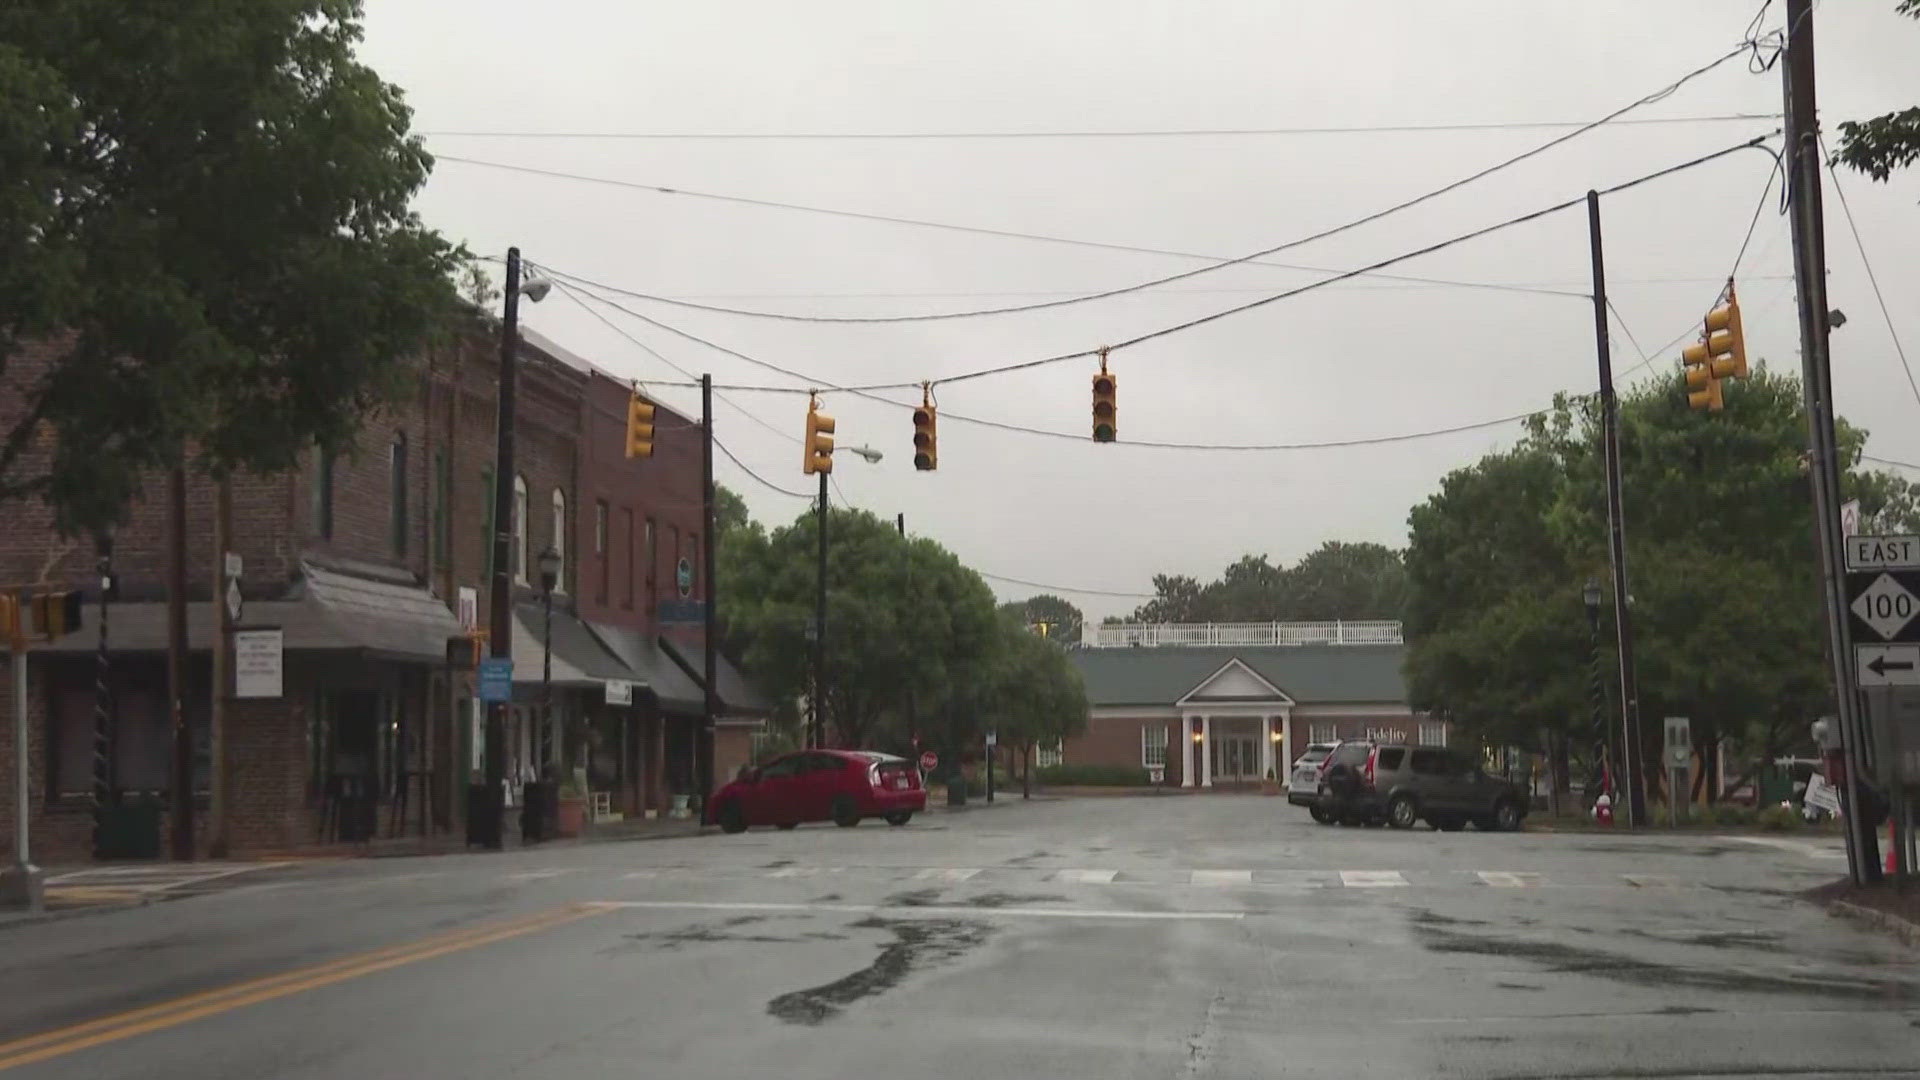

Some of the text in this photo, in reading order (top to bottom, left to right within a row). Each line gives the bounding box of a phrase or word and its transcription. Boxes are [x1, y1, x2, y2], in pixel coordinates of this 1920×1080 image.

[1859, 542, 1910, 562] EAST
[1866, 594, 1911, 619] 100
[1366, 727, 1408, 742] Fidelity
